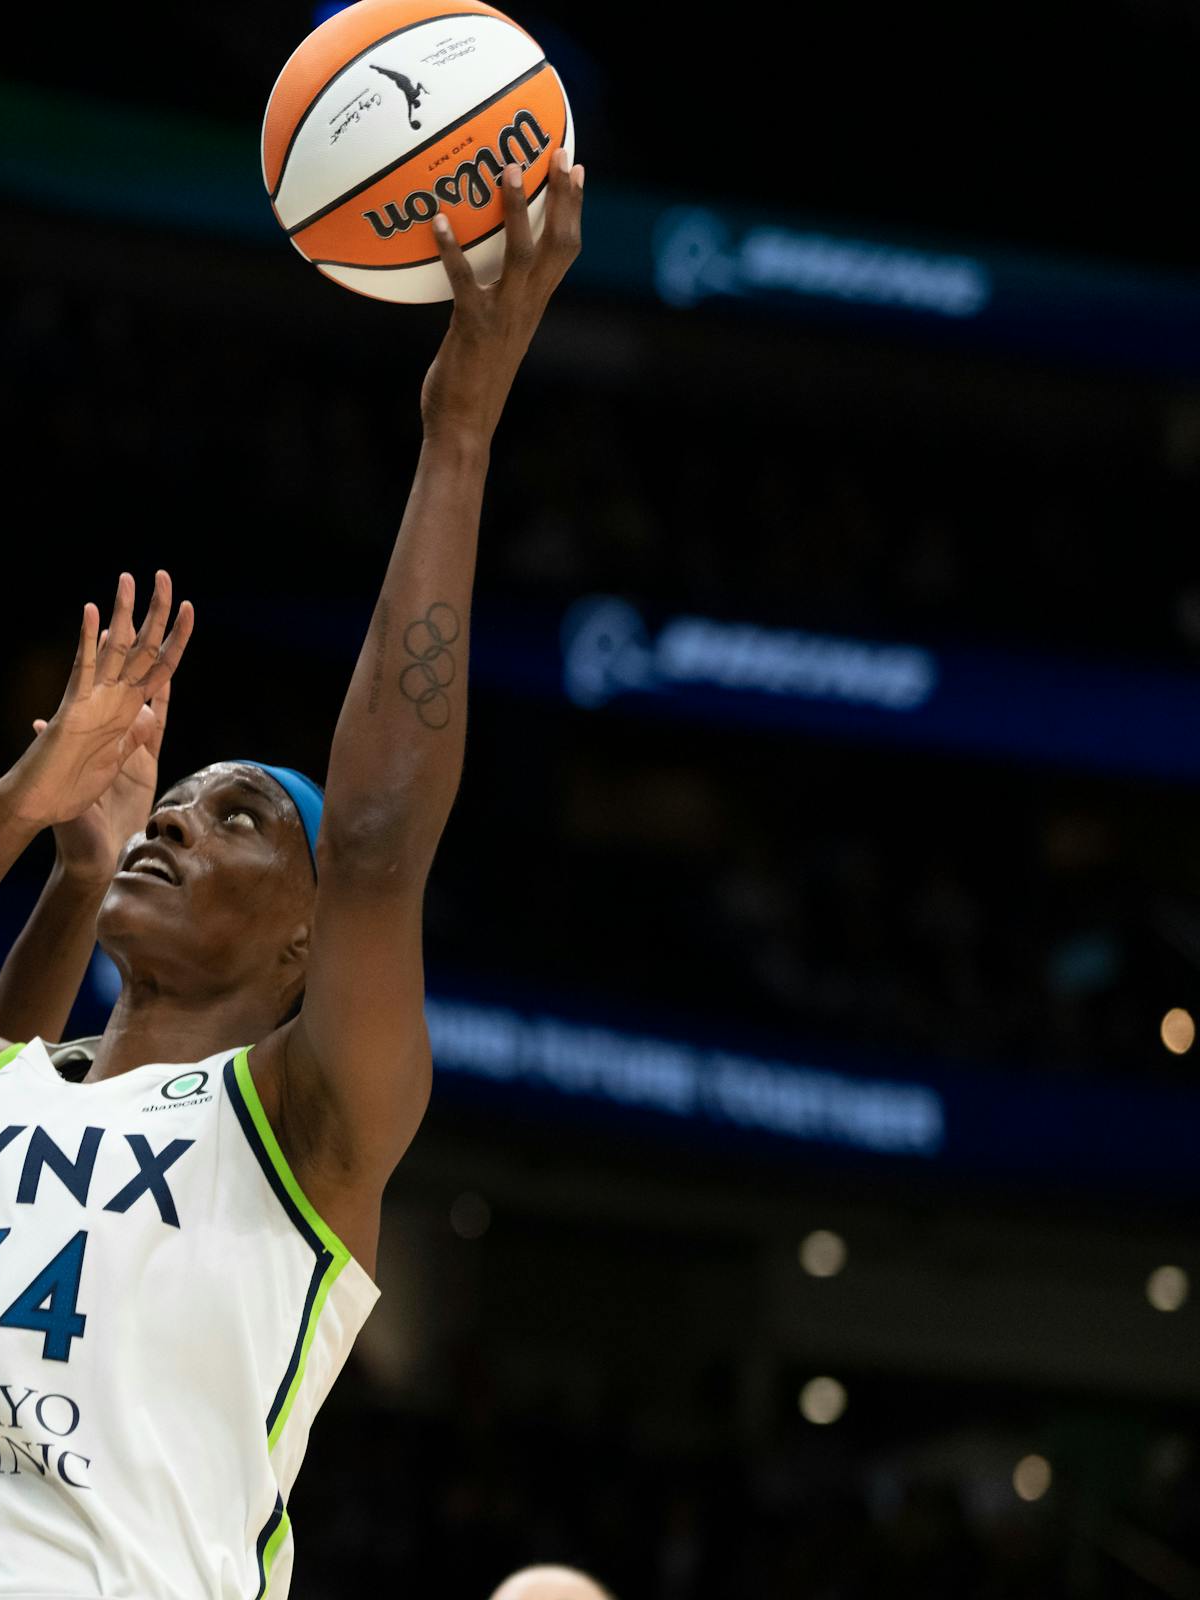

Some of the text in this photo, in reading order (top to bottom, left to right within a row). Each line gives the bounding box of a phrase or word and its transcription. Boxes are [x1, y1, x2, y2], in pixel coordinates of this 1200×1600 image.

[428, 136, 473, 171] EVO NXT
[361, 109, 551, 241] Wilson
[141, 1095, 213, 1113] sharecare
